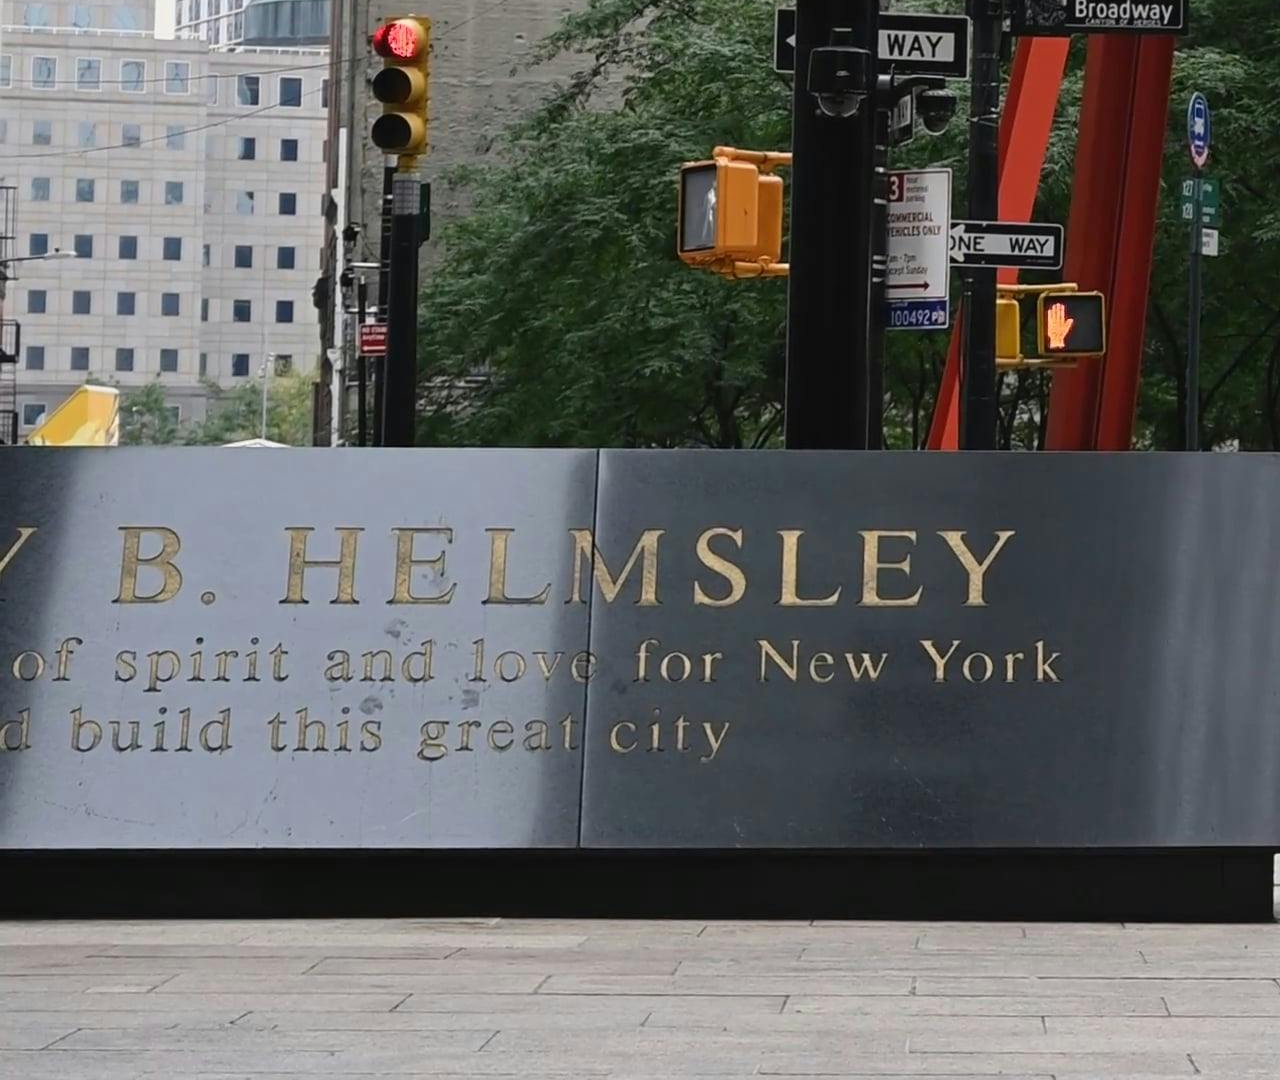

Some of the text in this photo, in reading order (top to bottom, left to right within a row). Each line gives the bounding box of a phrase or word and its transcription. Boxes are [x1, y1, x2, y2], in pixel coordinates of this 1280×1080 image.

[887, 33, 943, 58] WAY
[889, 176, 900, 201] 3
[1009, 237, 1049, 254] WAY
[111, 526, 216, 606] B.
[279, 526, 1015, 608] HELMSLEY
[12, 636, 1063, 692] of spirit and love for New York
[70, 705, 233, 753] build
[267, 706, 383, 753] this
[416, 711, 580, 761] great
[609, 706, 731, 762] city
